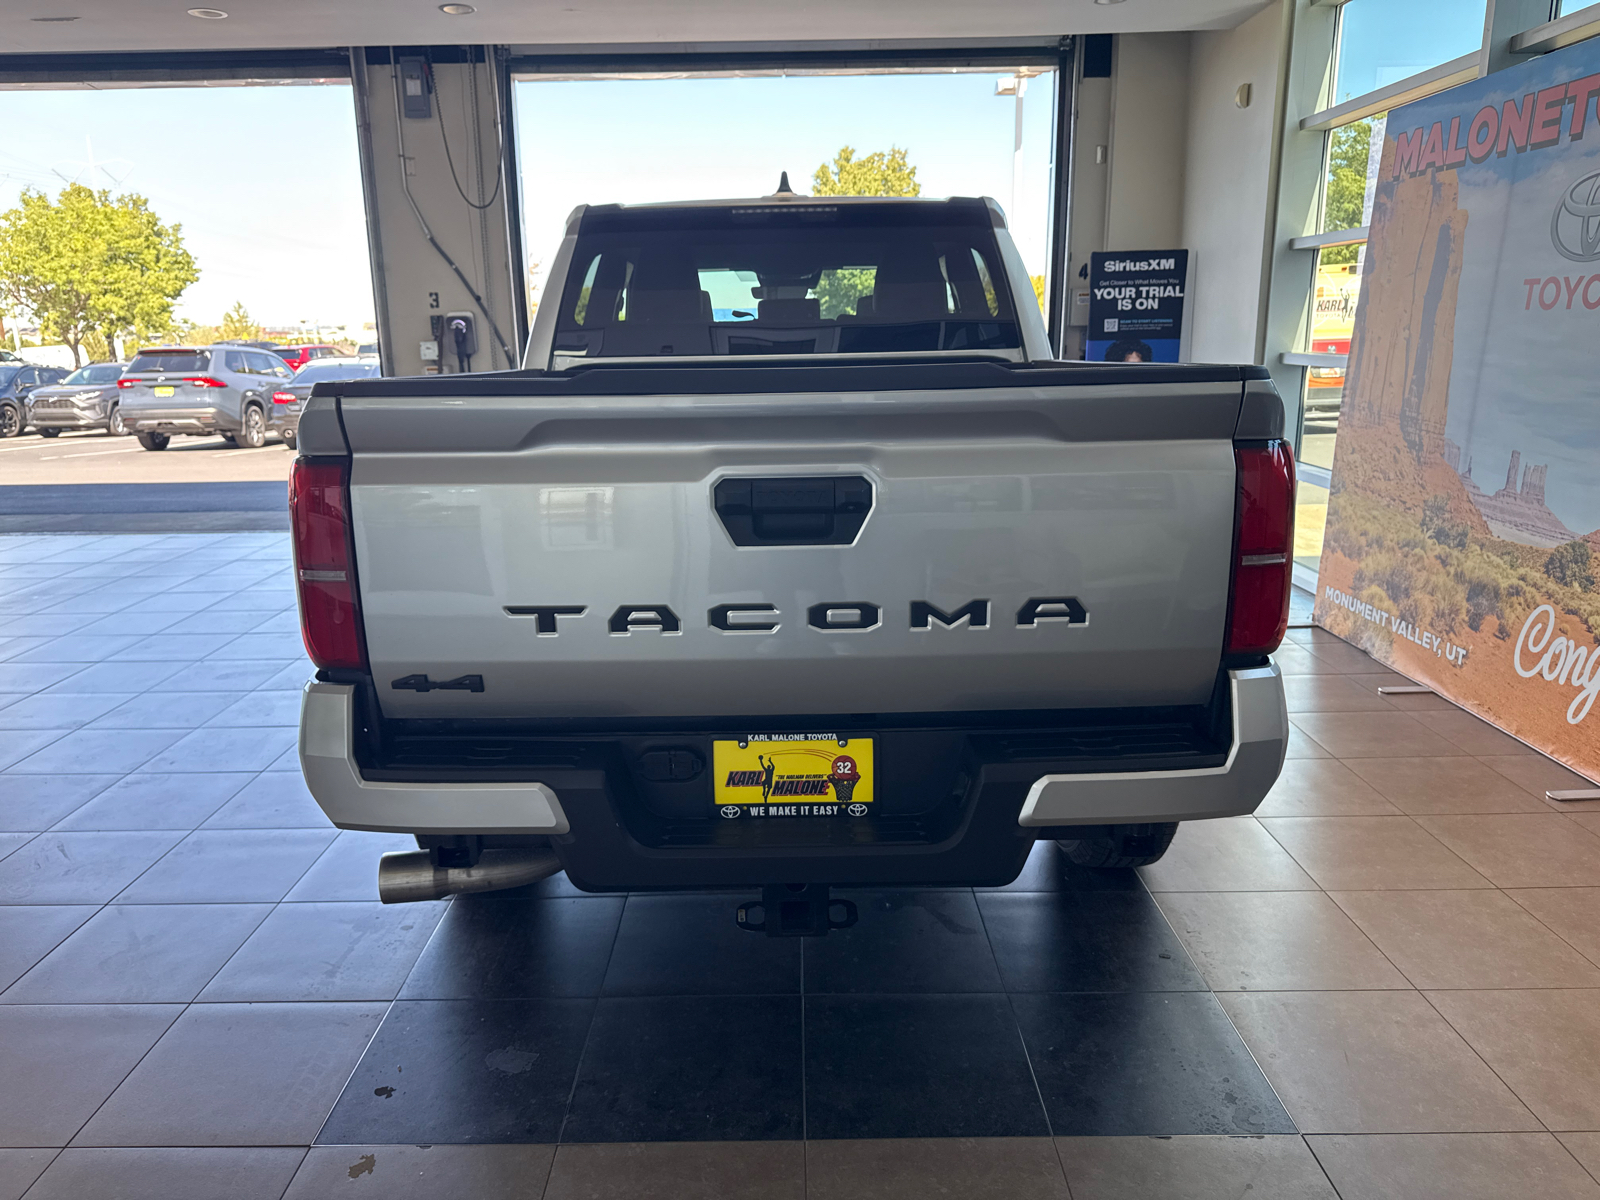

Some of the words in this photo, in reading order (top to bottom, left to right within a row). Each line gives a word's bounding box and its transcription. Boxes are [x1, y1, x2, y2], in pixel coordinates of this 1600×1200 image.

[1392, 72, 1600, 182] MALONET
[1078, 262, 1089, 280] 4
[1104, 258, 1175, 272] SiriusXM
[429, 292, 439, 308] 3
[1093, 287, 1136, 300] YOUR
[1139, 285, 1184, 298] TRIAL
[1117, 299, 1132, 311] IS
[1135, 298, 1159, 310] ON
[1316, 299, 1342, 312] KARL
[503, 597, 1091, 637] TACOMA
[1325, 585, 1389, 627] MONUMENT
[1391, 618, 1442, 657] VALLEY,
[1445, 642, 1467, 665] UT
[747, 734, 770, 742] KARL
[806, 733, 838, 741] TOYOTA
[836, 761, 852, 774] 32
[725, 770, 765, 787] KARL
[771, 780, 829, 796] MALONE
[750, 806, 765, 816] WE
[769, 806, 797, 816] MAKE
[800, 806, 810, 815] IT
[813, 805, 839, 815] EASY
